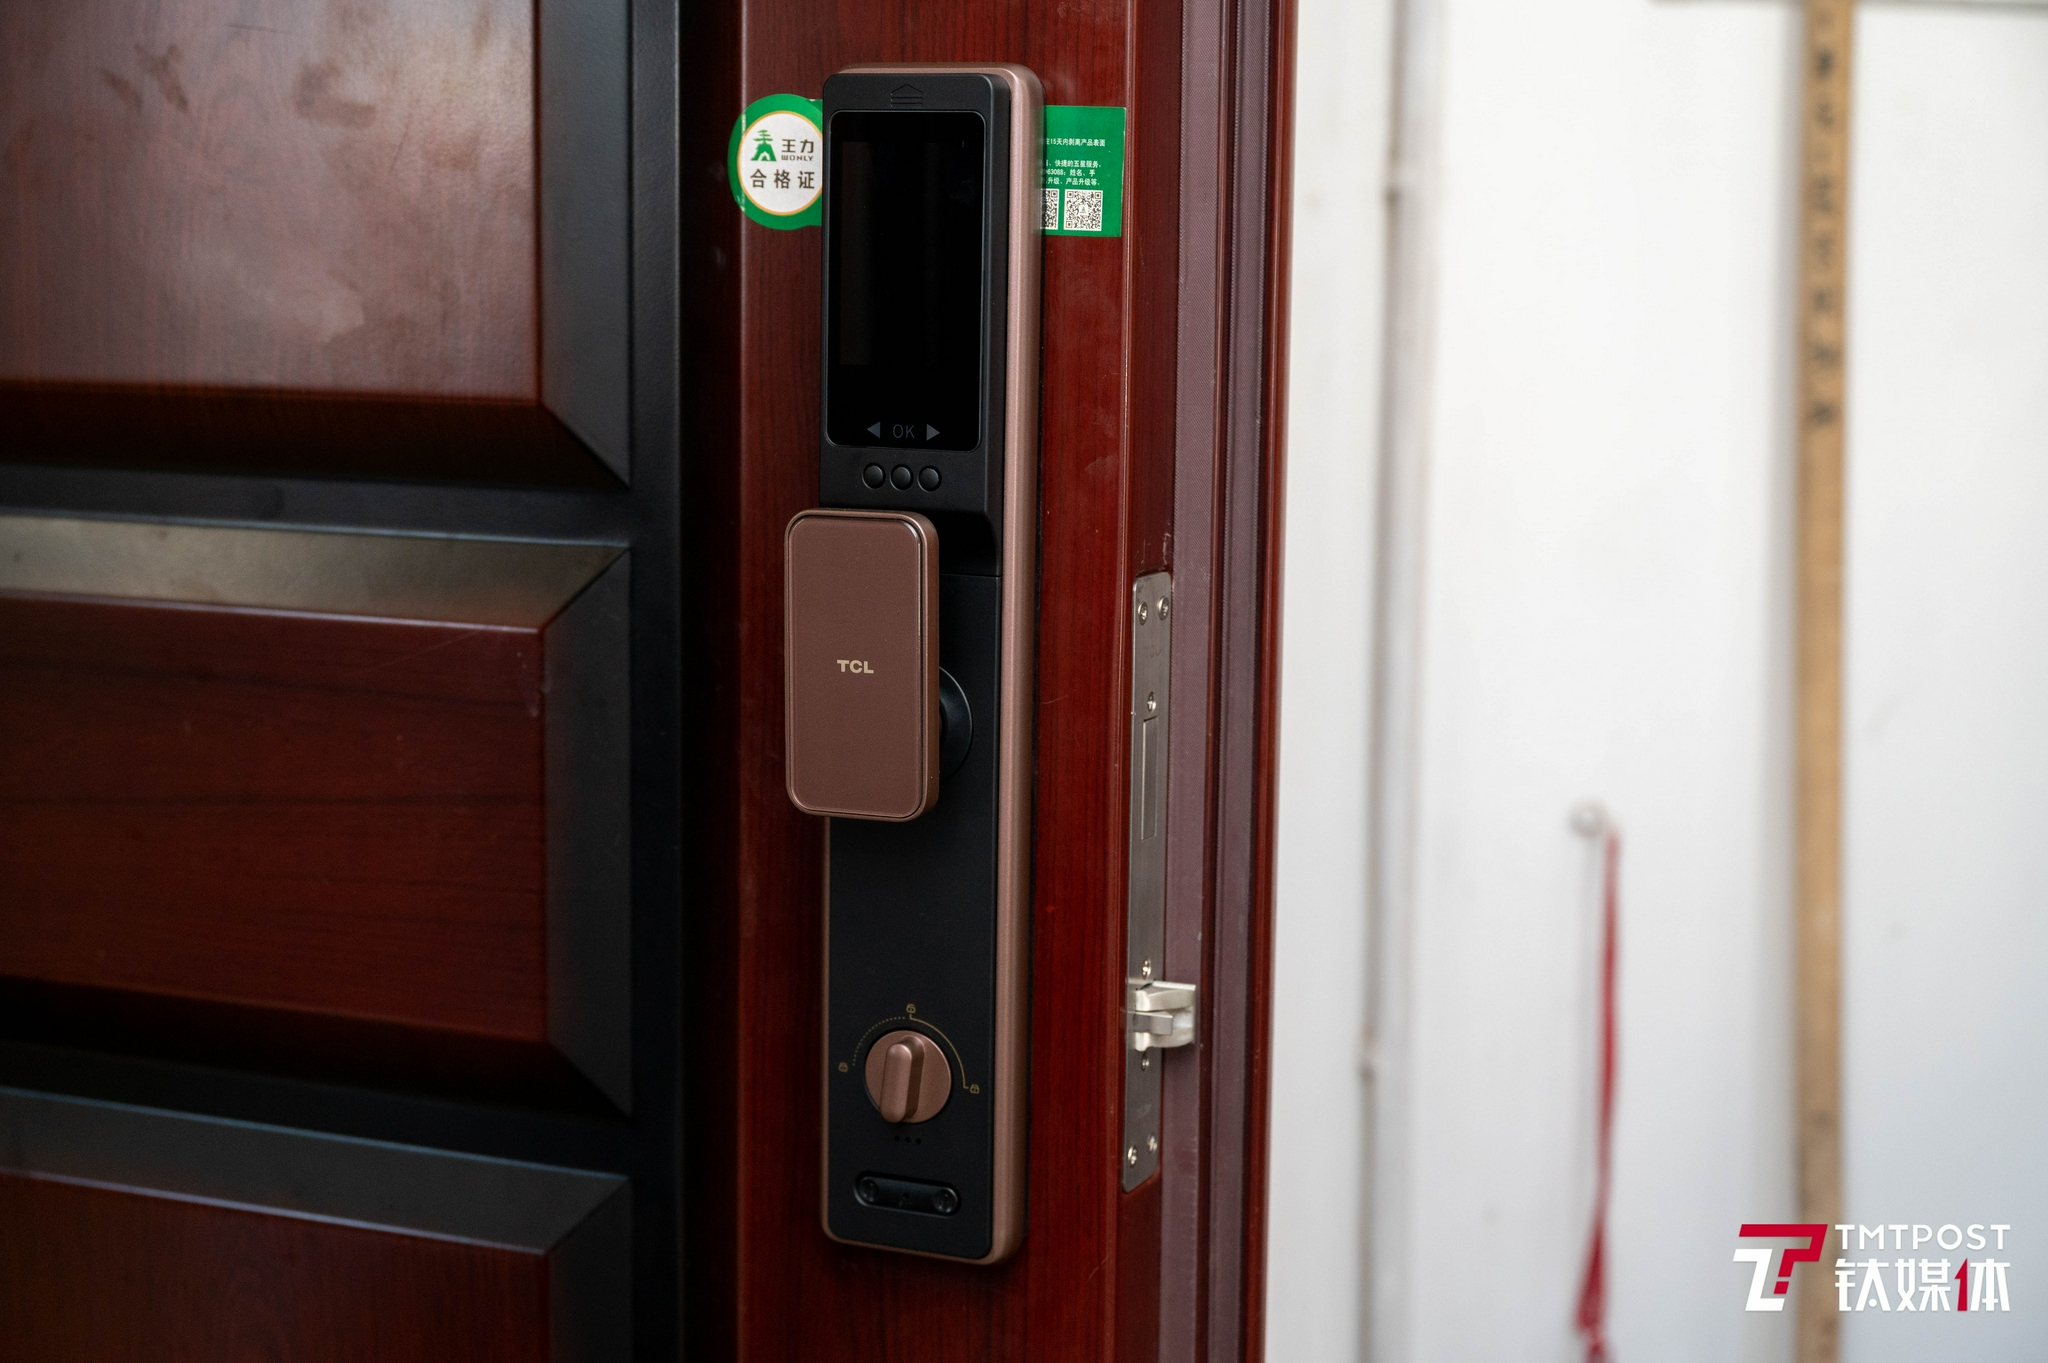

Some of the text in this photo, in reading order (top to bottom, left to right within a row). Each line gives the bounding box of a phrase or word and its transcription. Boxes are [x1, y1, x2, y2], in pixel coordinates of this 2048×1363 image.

[781, 138, 815, 153] 王力
[750, 168, 815, 189] 合格证
[892, 424, 915, 439] OK
[837, 659, 874, 674] TCL
